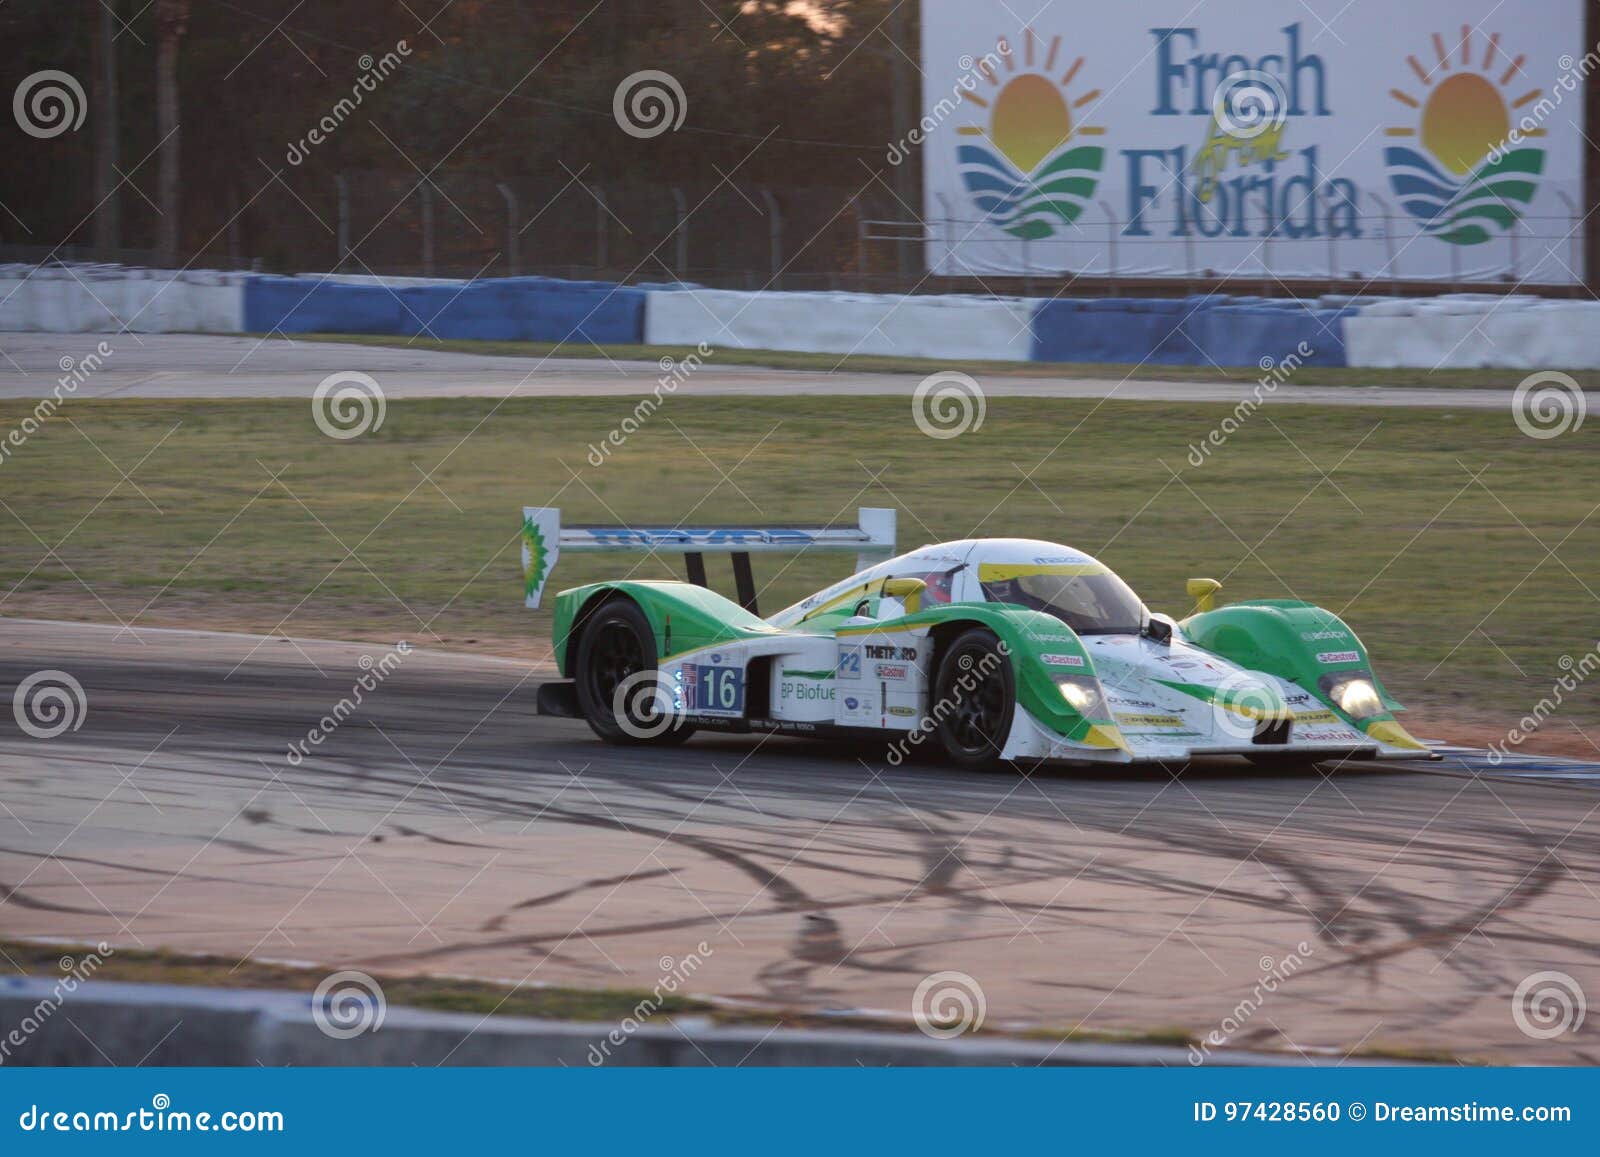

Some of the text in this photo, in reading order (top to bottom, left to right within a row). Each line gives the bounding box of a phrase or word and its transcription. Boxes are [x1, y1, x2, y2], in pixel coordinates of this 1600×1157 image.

[1119, 144, 1365, 239] Florida
[840, 652, 859, 672] P2
[865, 645, 917, 661] THETFORD
[703, 669, 736, 709] 16
[781, 682, 794, 699] BP
